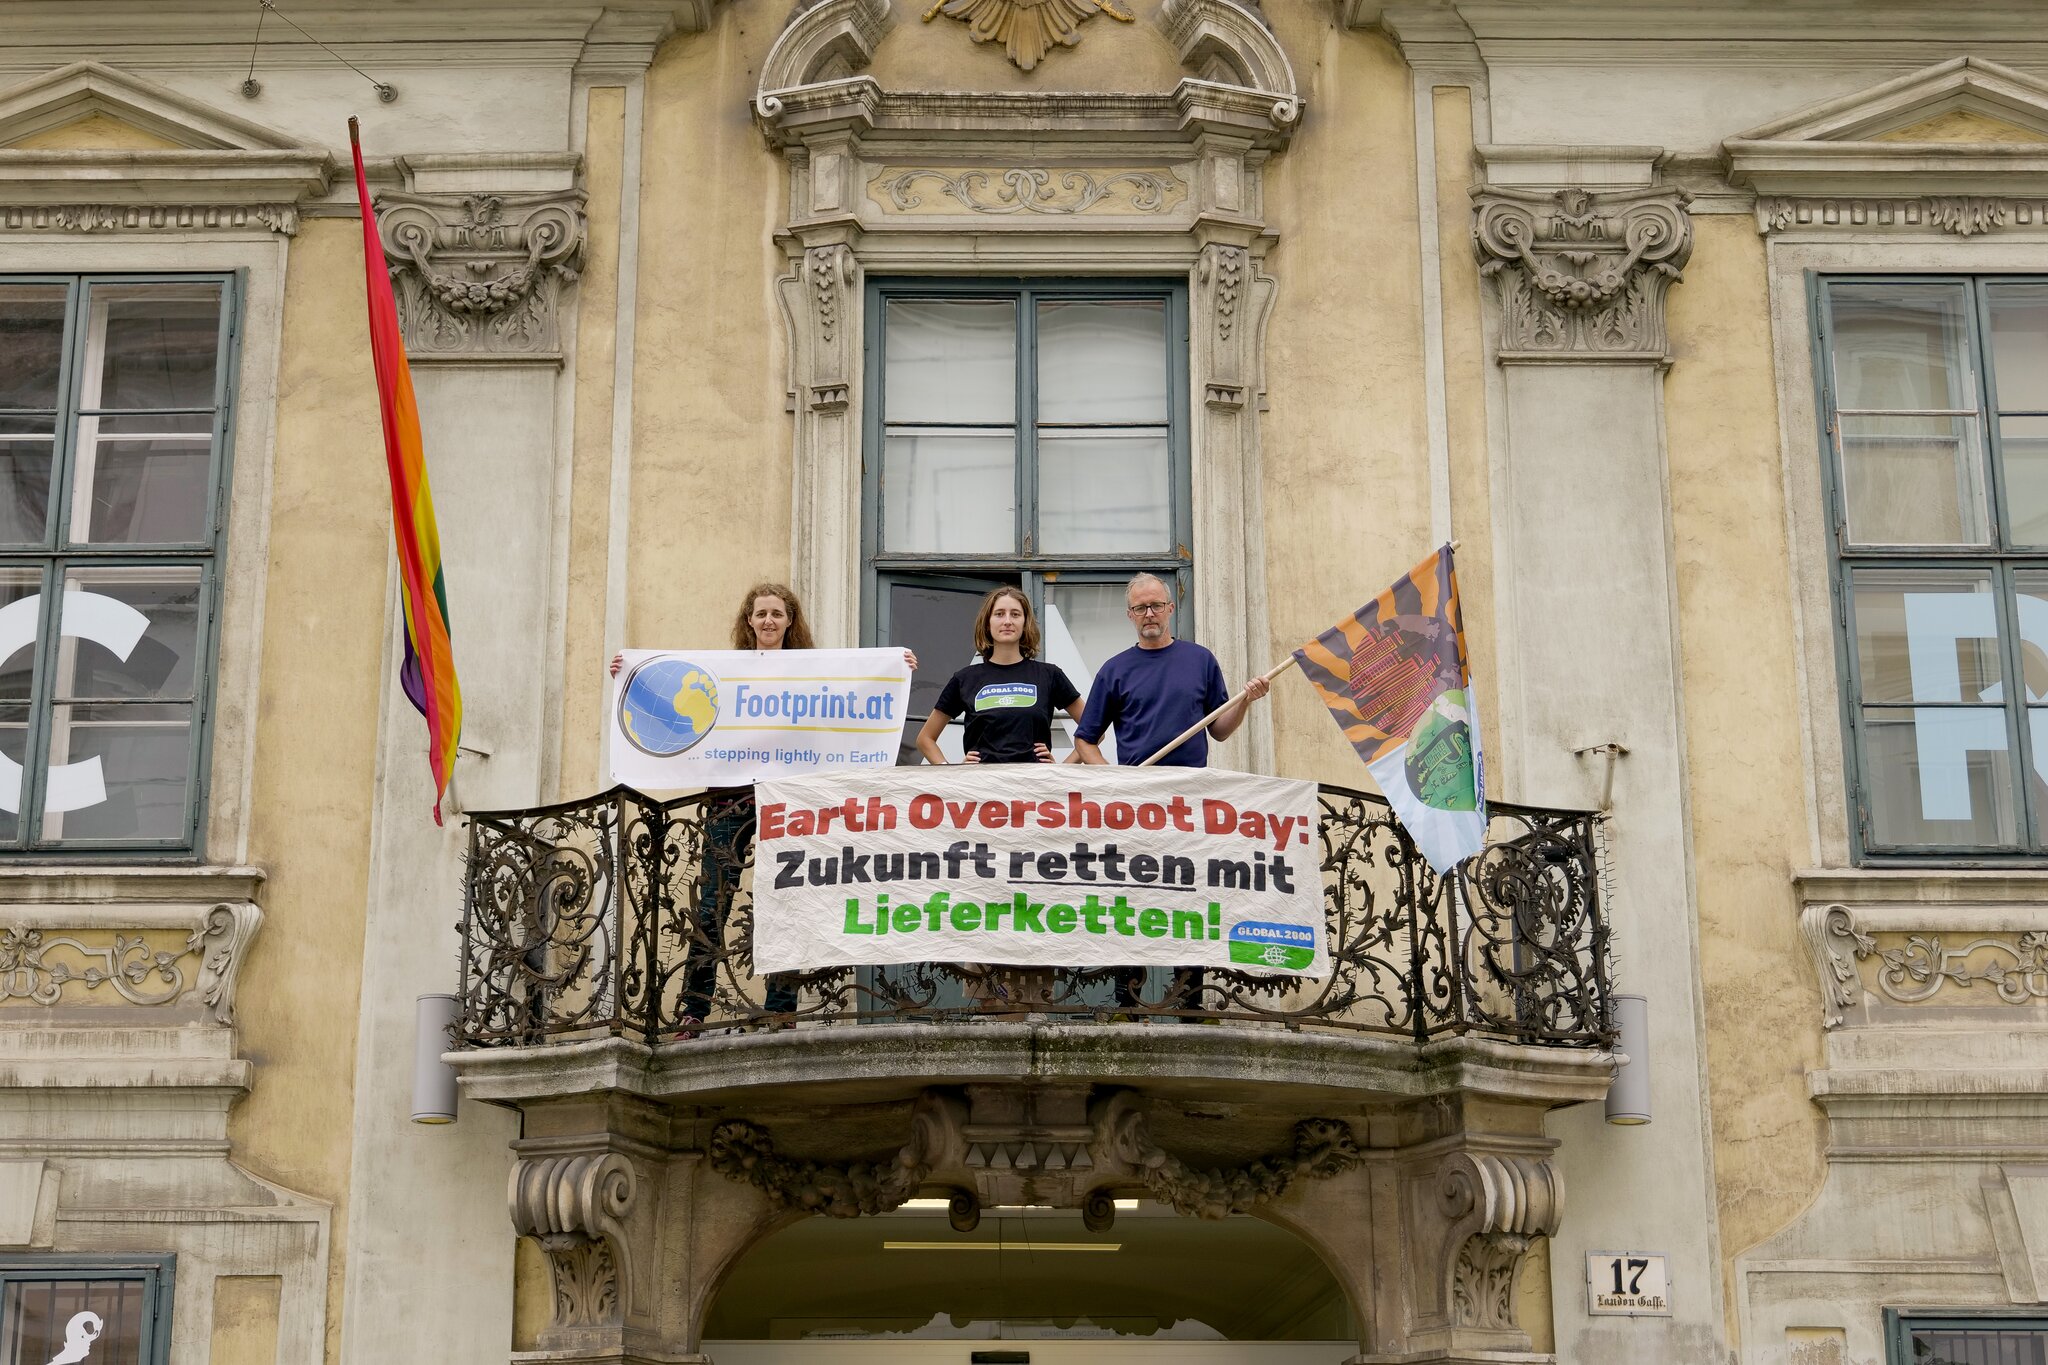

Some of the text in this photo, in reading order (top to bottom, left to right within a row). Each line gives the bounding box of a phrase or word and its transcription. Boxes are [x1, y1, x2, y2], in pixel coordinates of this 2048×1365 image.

[735, 685, 894, 725] Footprint.at
[981, 686, 1034, 696] GLOBAL 2000
[704, 748, 771, 763] stepping
[775, 748, 821, 765] lightly
[826, 753, 845, 763] on
[850, 750, 888, 763] Earth
[760, 792, 1309, 851] Earth Overshoot Day:
[774, 841, 1295, 894] Zukunft retten mit
[843, 892, 1221, 940] Lieferketten!
[1237, 926, 1283, 938] GLOBAL
[1611, 1258, 1648, 1295] 17
